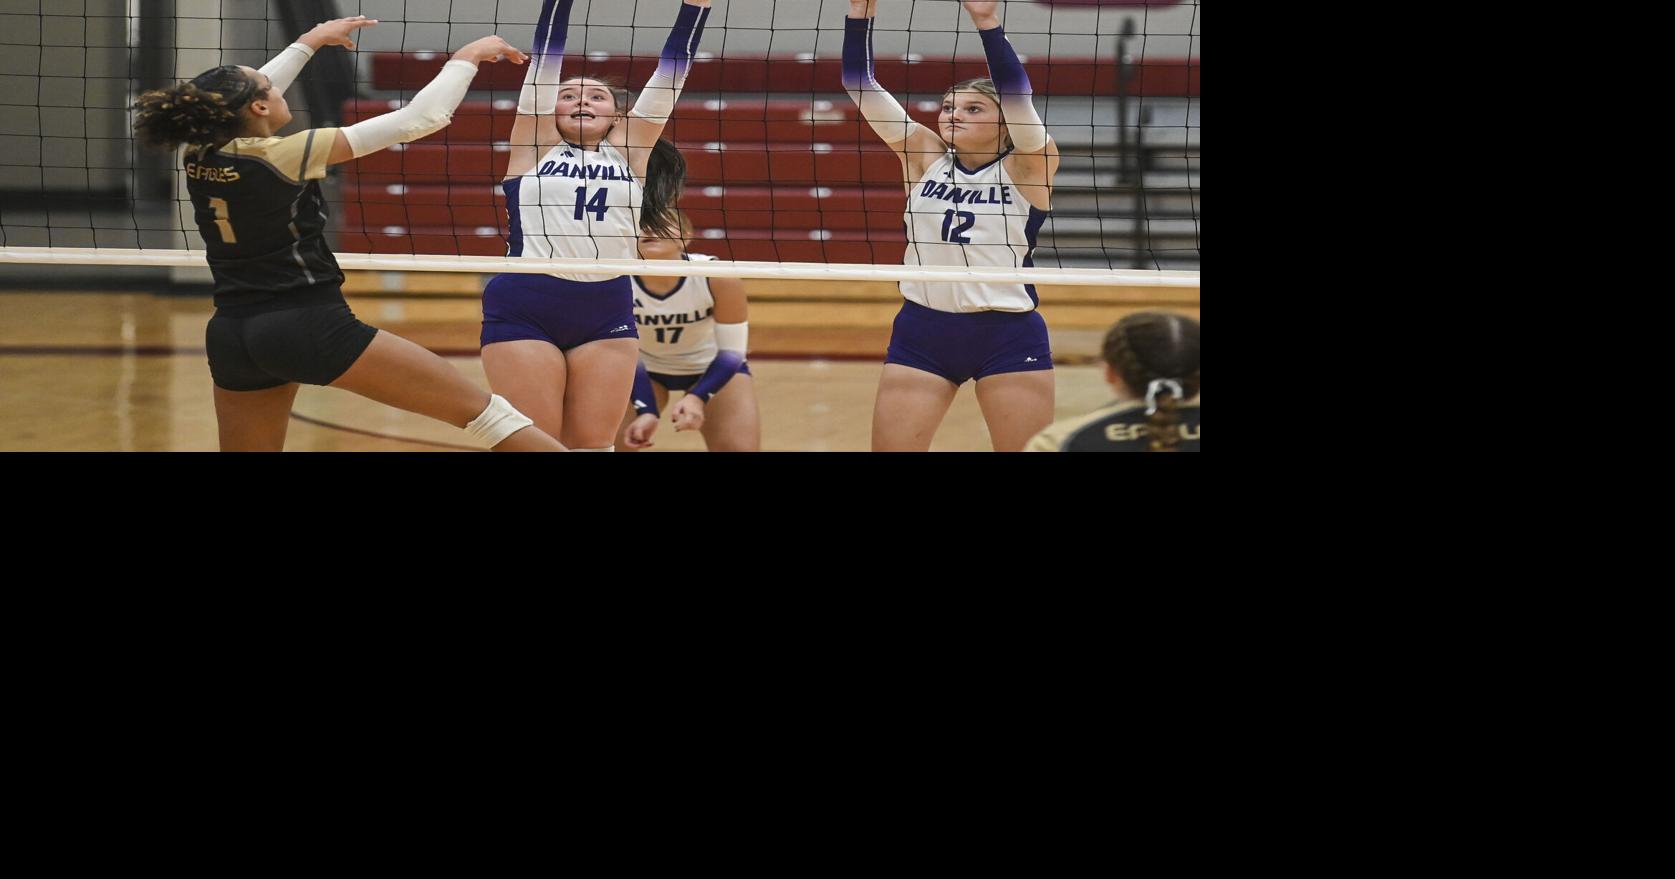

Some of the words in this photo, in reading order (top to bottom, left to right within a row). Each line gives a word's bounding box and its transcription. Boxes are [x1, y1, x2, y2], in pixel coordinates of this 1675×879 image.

[538, 160, 634, 182] DANVILL
[574, 187, 609, 221] 14
[920, 180, 1012, 204] DANVILLE
[209, 196, 237, 244] 1
[941, 209, 975, 244] 12
[655, 327, 684, 344] 17
